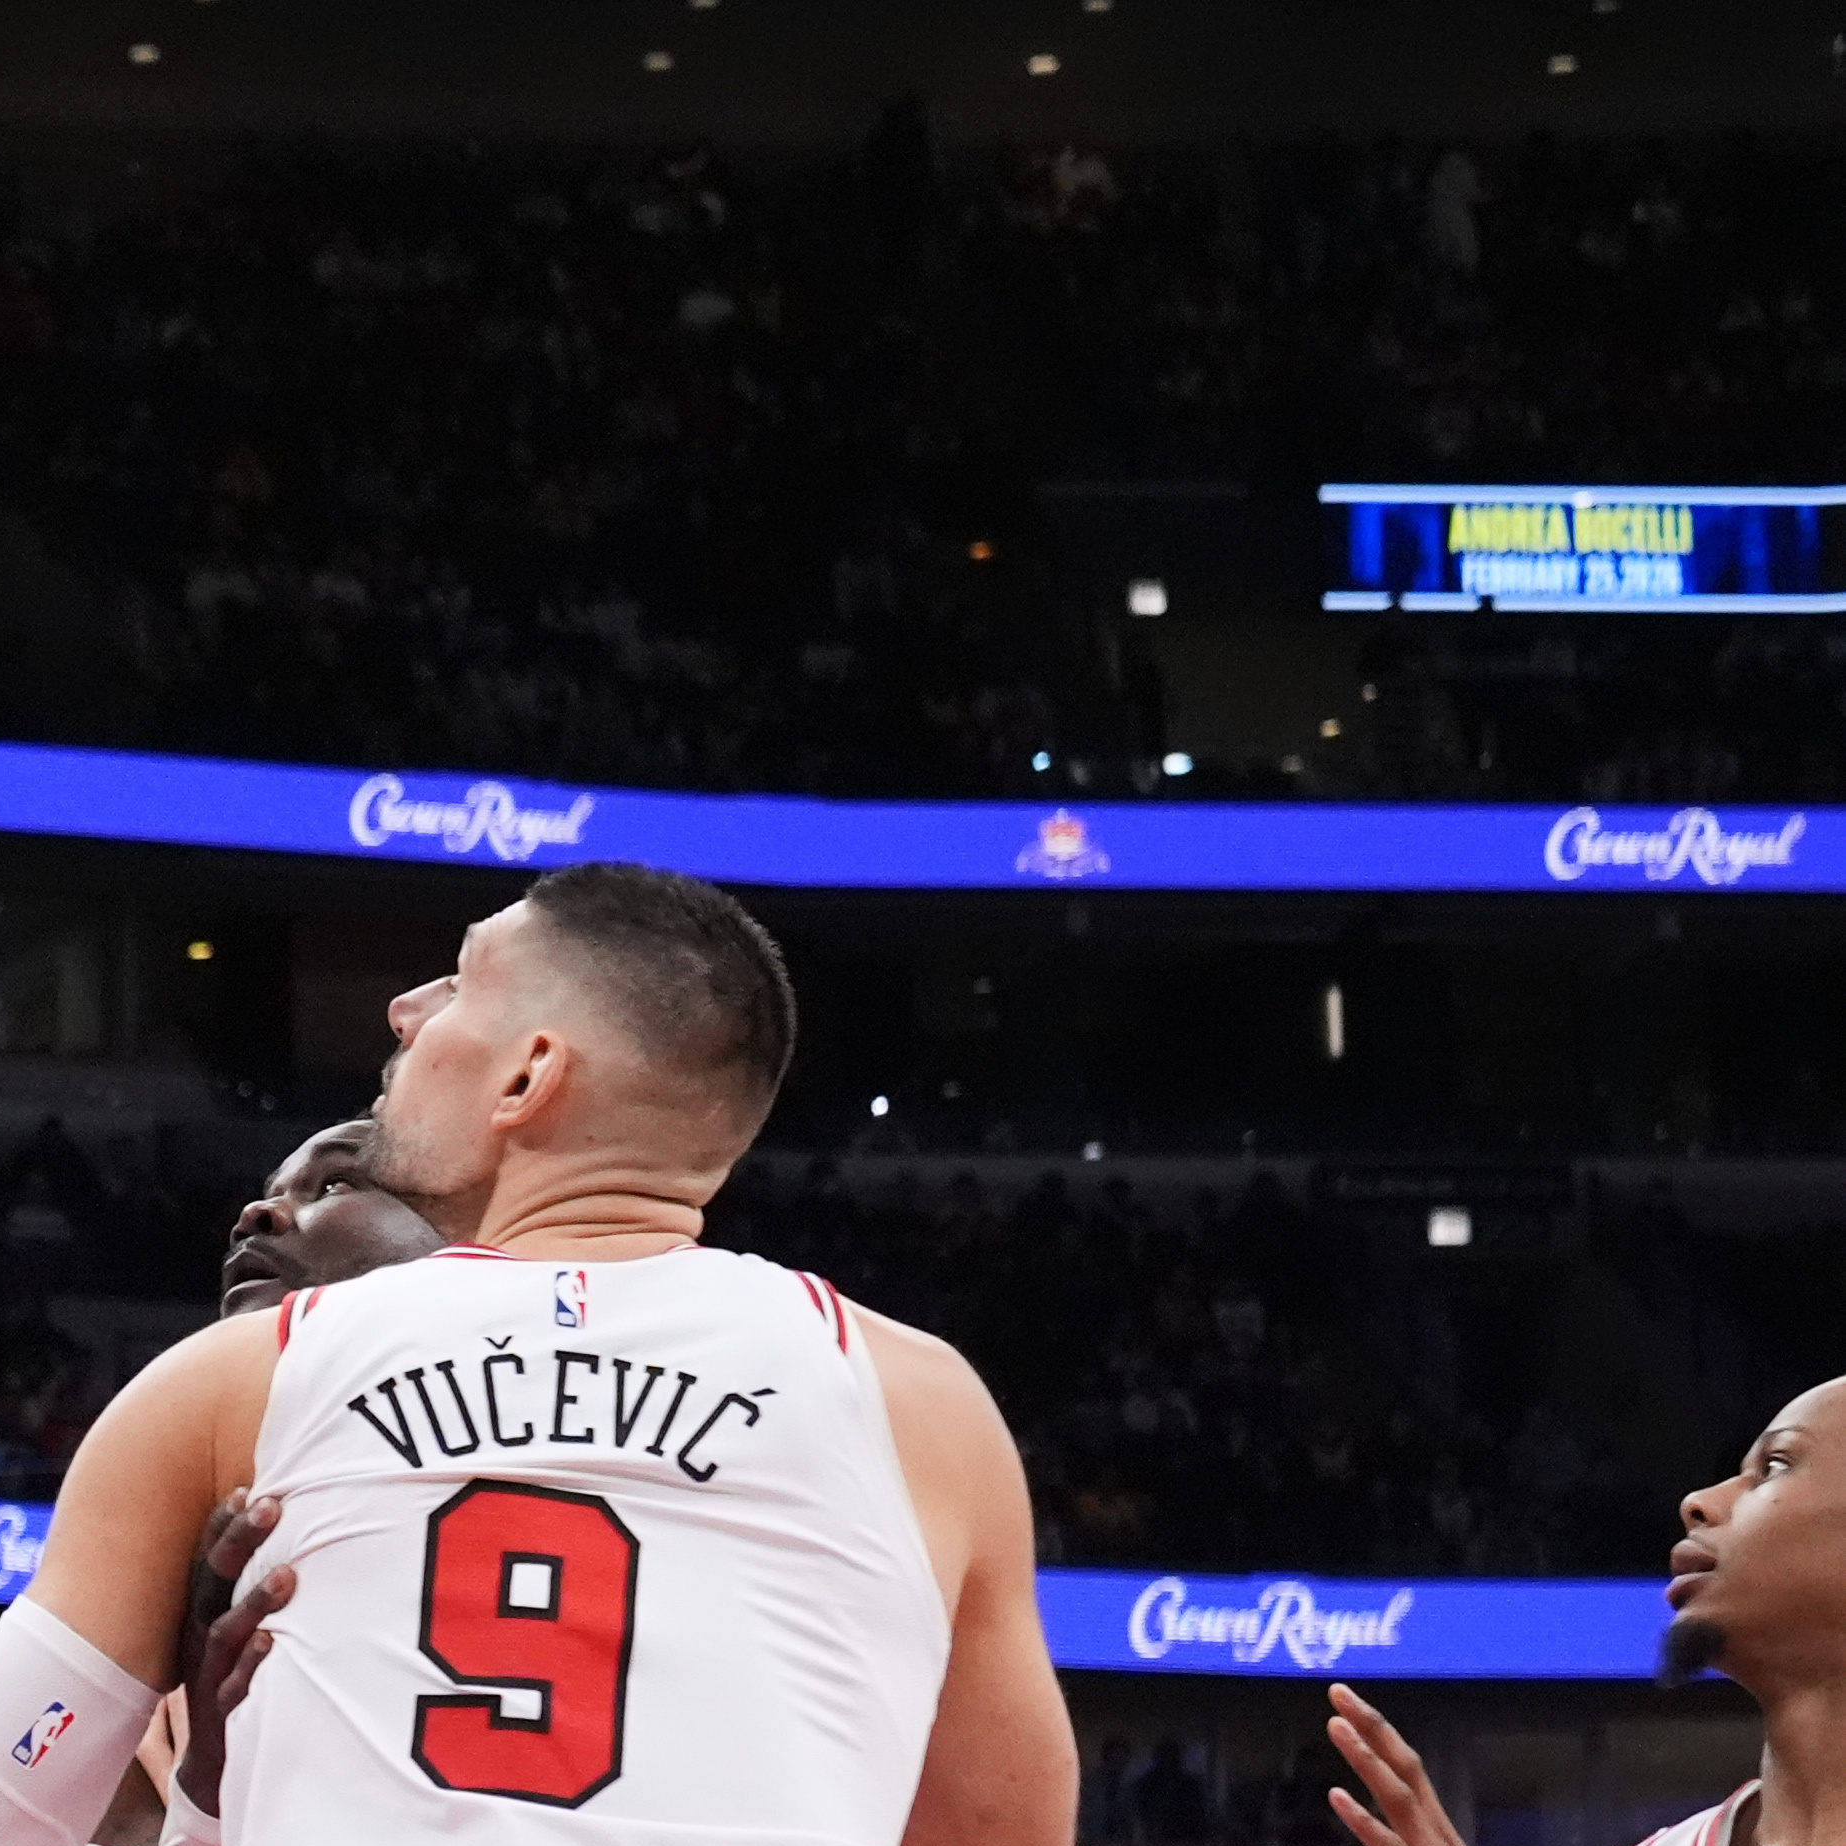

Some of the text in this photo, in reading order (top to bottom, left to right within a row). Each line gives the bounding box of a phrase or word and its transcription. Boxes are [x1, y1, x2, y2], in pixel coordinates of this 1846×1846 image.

[349, 773, 597, 862] Crown Royal
[1544, 806, 1807, 886] Crown Royal
[347, 1334, 778, 1483] VUČEVIĆ
[410, 1476, 641, 1810] 9
[1127, 1576, 1414, 1669] Crown Royal
